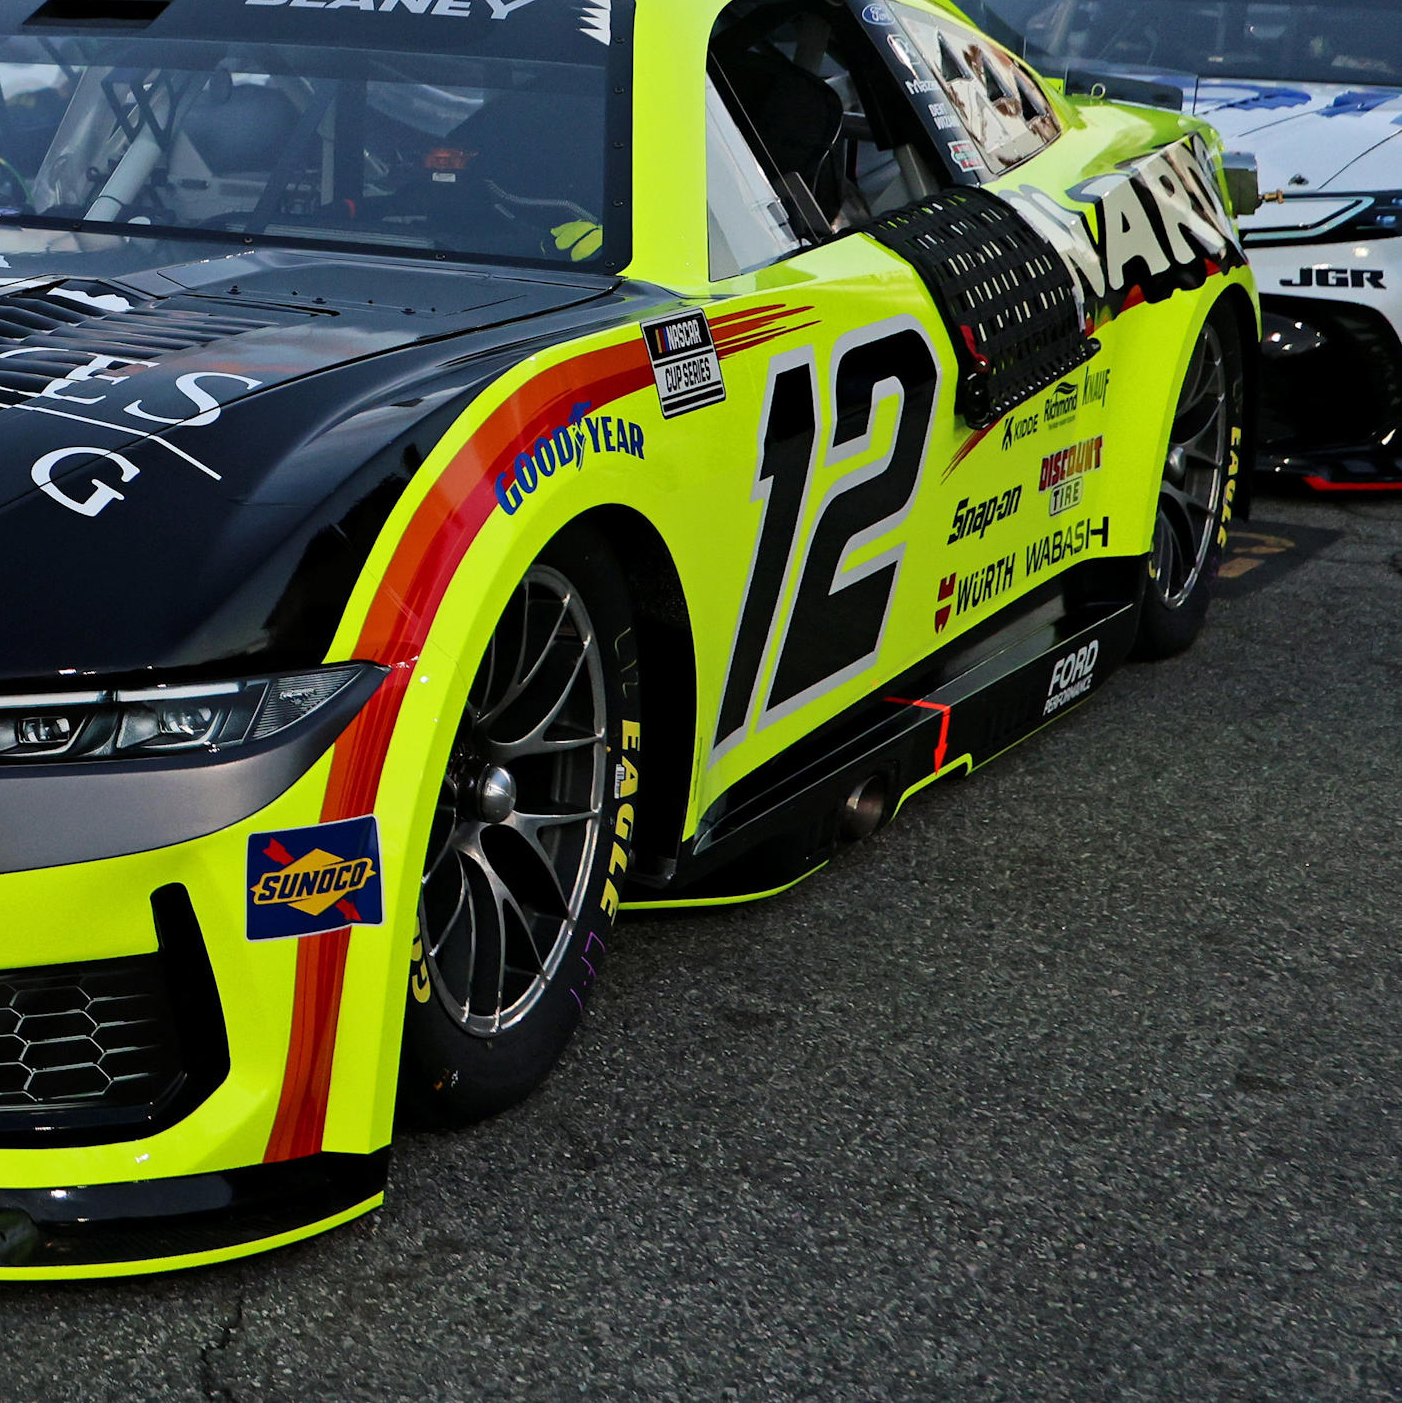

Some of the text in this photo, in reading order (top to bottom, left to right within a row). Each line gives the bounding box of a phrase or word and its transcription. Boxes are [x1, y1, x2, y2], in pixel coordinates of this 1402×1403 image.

[1279, 267, 1387, 289] JGR
[666, 319, 702, 351] NASCAR
[665, 357, 712, 393] CUP SERIES
[1013, 413, 1039, 442] KIDDE
[1044, 387, 1079, 423] Richmond
[1082, 365, 1111, 408] KNAUF
[1039, 434, 1103, 493] DISCOUNT
[947, 484, 1023, 546] Snap-on
[1052, 480, 1080, 512] TIRE
[711, 313, 943, 759] 12
[1026, 516, 1110, 578] WABASH
[957, 552, 1016, 616] WÜRTH
[1043, 673, 1094, 716] PERFORMANCE
[1048, 639, 1100, 697] FORD
[599, 719, 642, 927] EAGLE
[257, 861, 368, 902] SUNOCO
